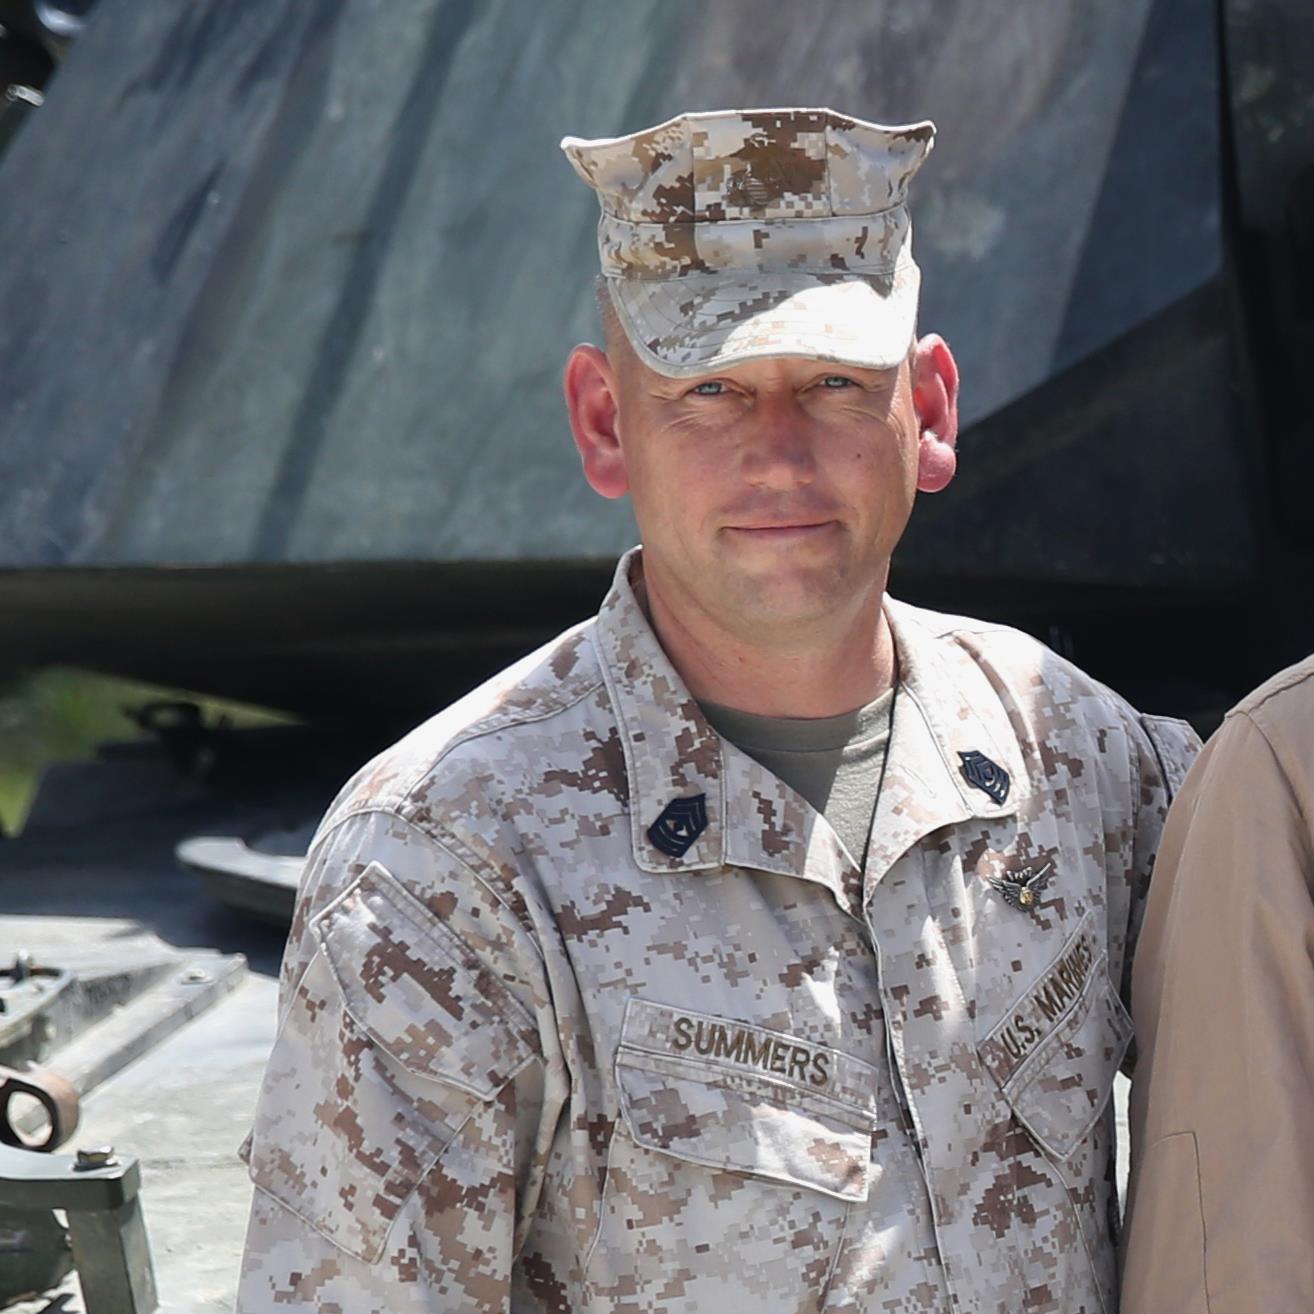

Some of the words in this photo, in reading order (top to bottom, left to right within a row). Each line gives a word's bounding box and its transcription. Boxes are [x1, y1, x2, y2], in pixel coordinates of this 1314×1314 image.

[1000, 1014, 1042, 1058] U.S.
[1034, 939, 1094, 1021] MARINES
[673, 1016, 830, 1087] SUMMERS
